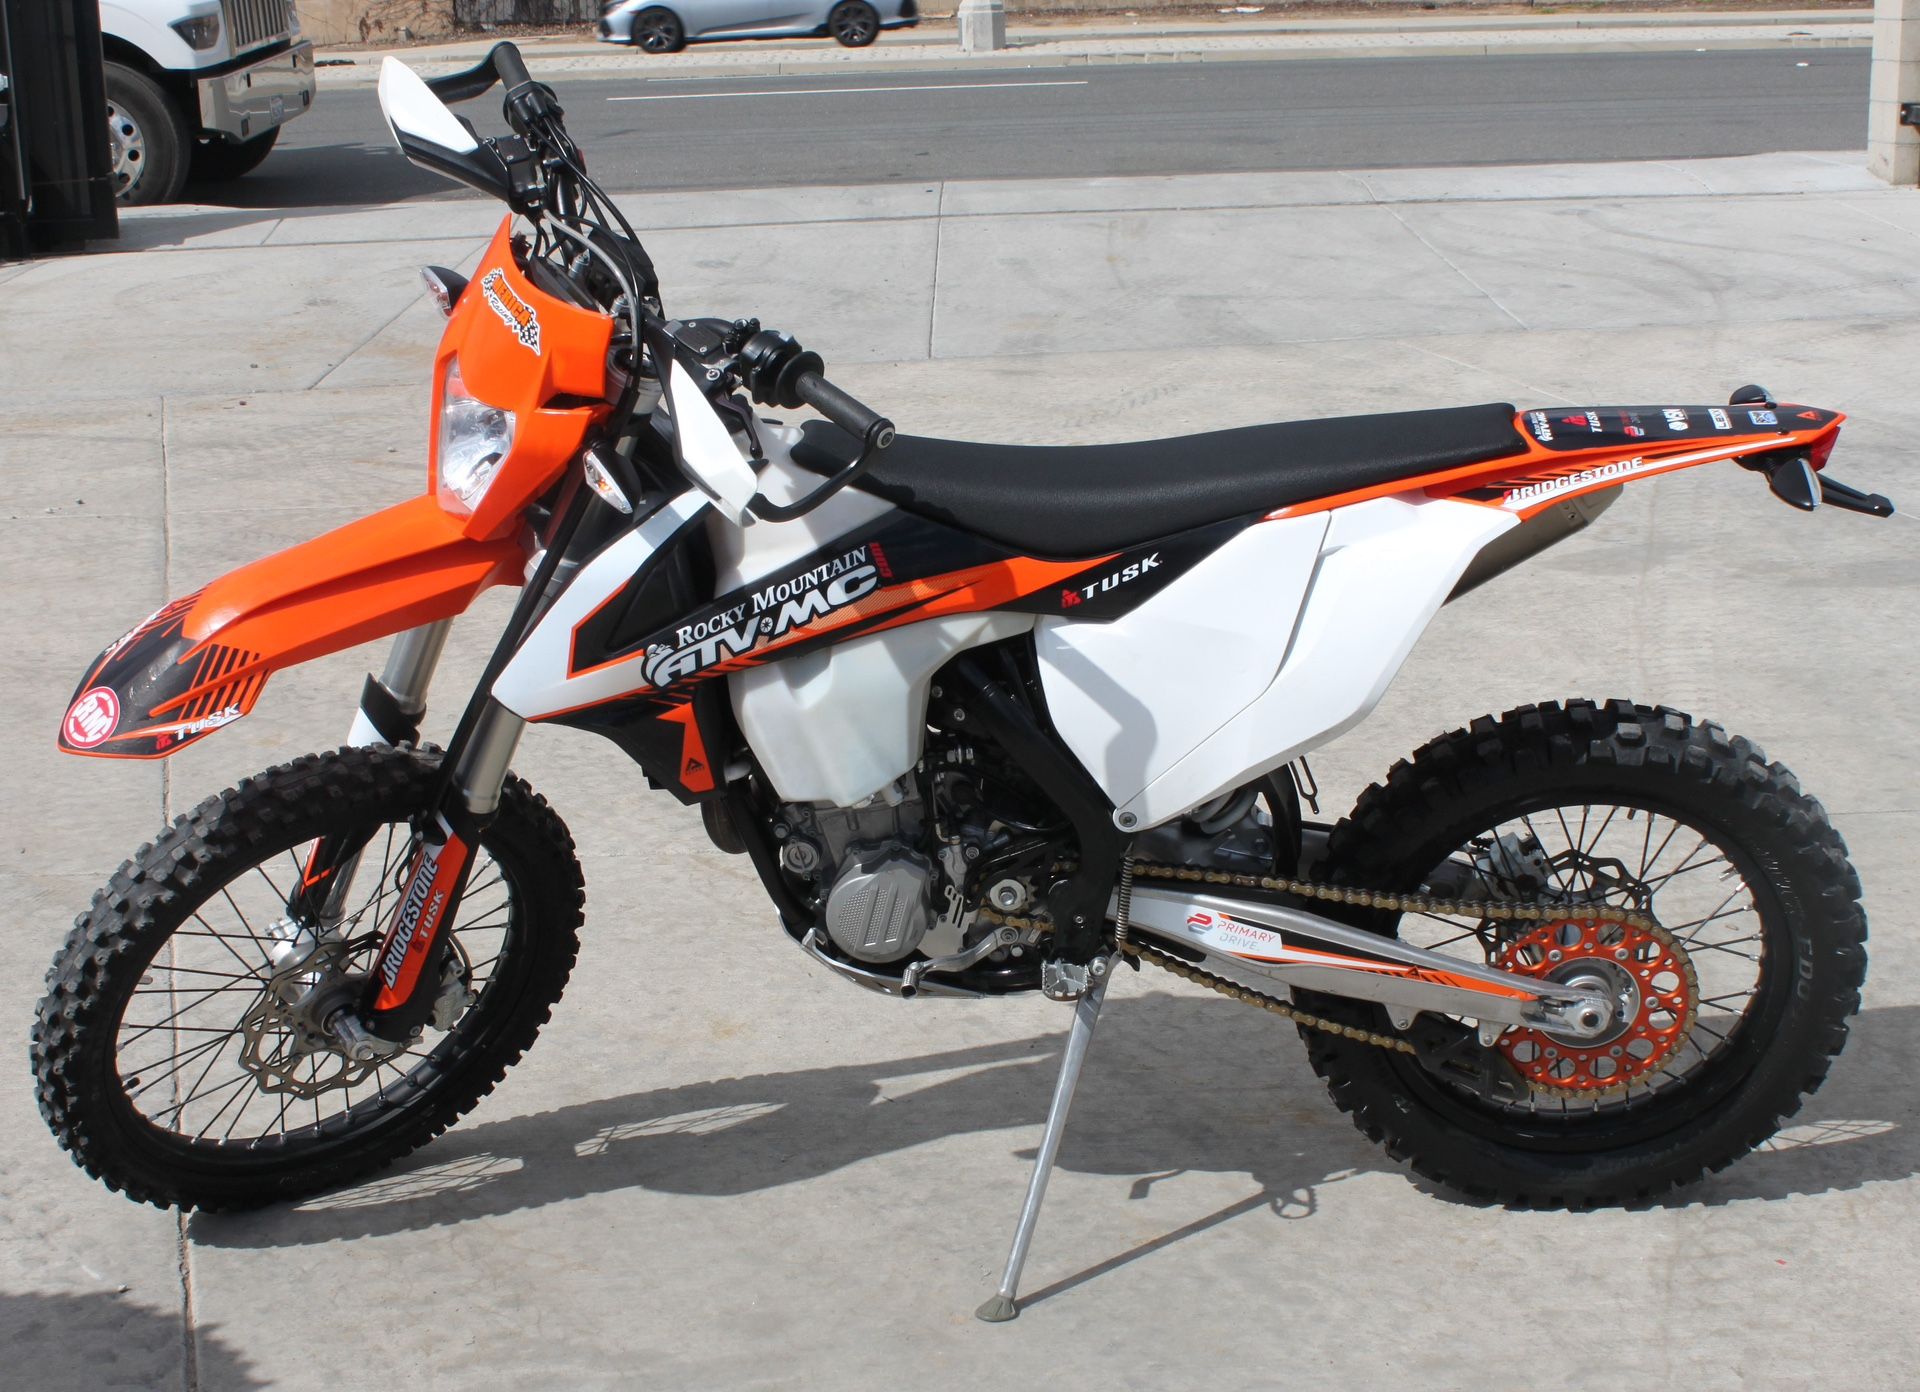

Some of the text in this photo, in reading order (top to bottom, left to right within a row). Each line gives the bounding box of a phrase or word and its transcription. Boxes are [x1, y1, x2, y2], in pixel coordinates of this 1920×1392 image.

[1585, 411, 1602, 432] TUSK
[1503, 457, 1644, 504] BRIDGESTONE
[676, 546, 867, 649] ROCKY MOUNTAIN
[1081, 552, 1160, 599] TUSK
[175, 702, 240, 740] TUSK
[382, 852, 438, 990] BRIDGESTONE
[420, 888, 445, 939] TUSK
[1215, 920, 1276, 943] PRIMARY
[1220, 932, 1259, 950] DRIVE
